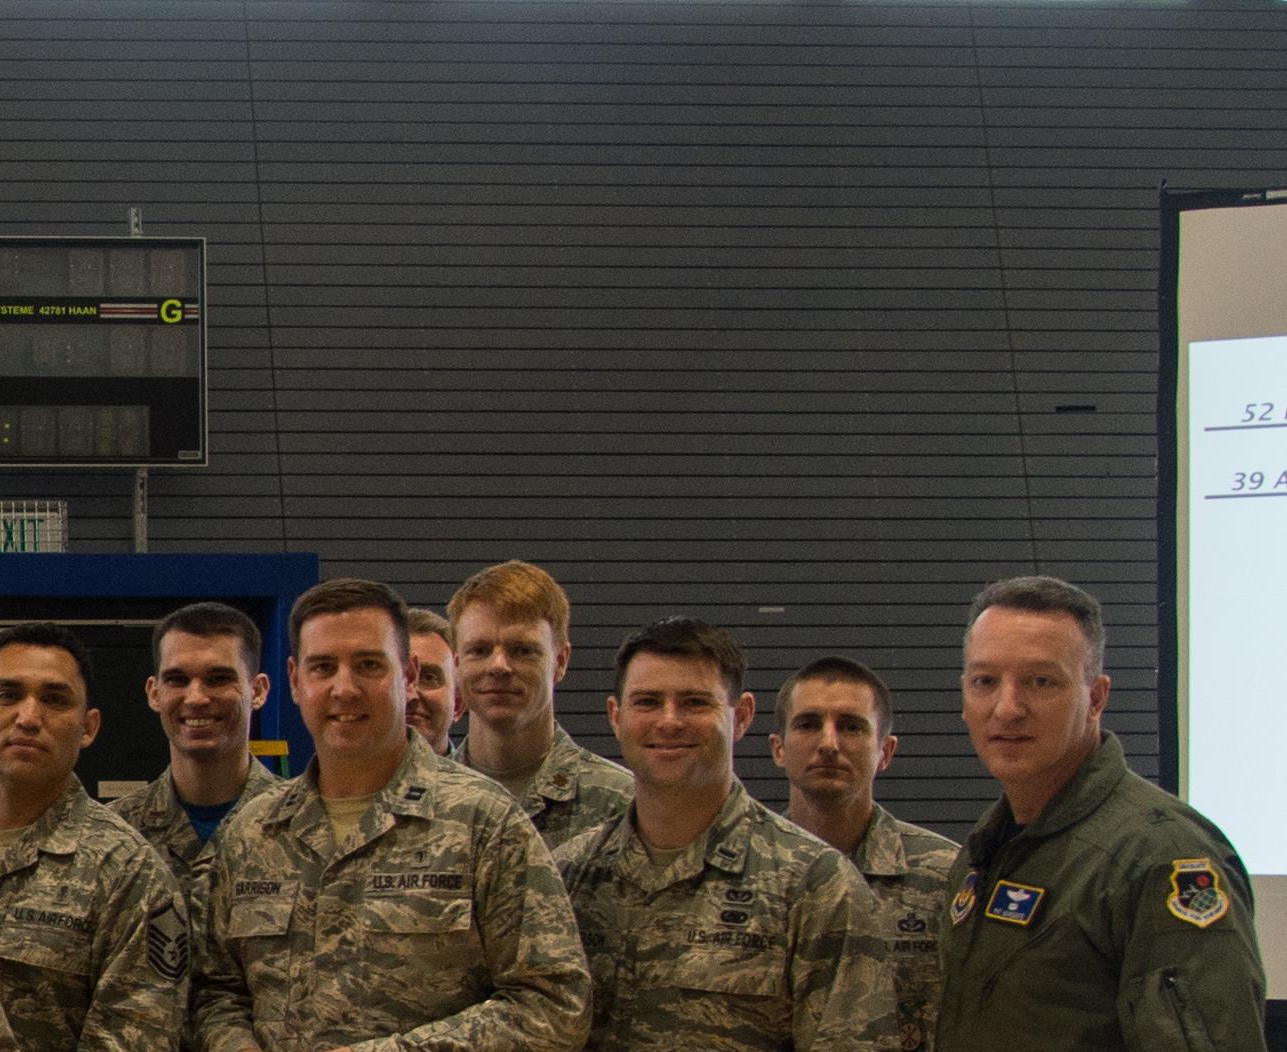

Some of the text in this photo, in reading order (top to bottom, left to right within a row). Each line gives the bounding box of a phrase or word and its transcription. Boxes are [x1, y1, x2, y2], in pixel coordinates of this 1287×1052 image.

[39, 306, 67, 316] 42781
[69, 306, 97, 316] HAAN
[160, 299, 183, 323] G
[1240, 402, 1274, 423] 52
[1231, 471, 1265, 491] 39
[372, 874, 463, 890] U.S. AIR FORCE
[712, 934, 734, 948] AIR
[734, 935, 776, 951] FORCE
